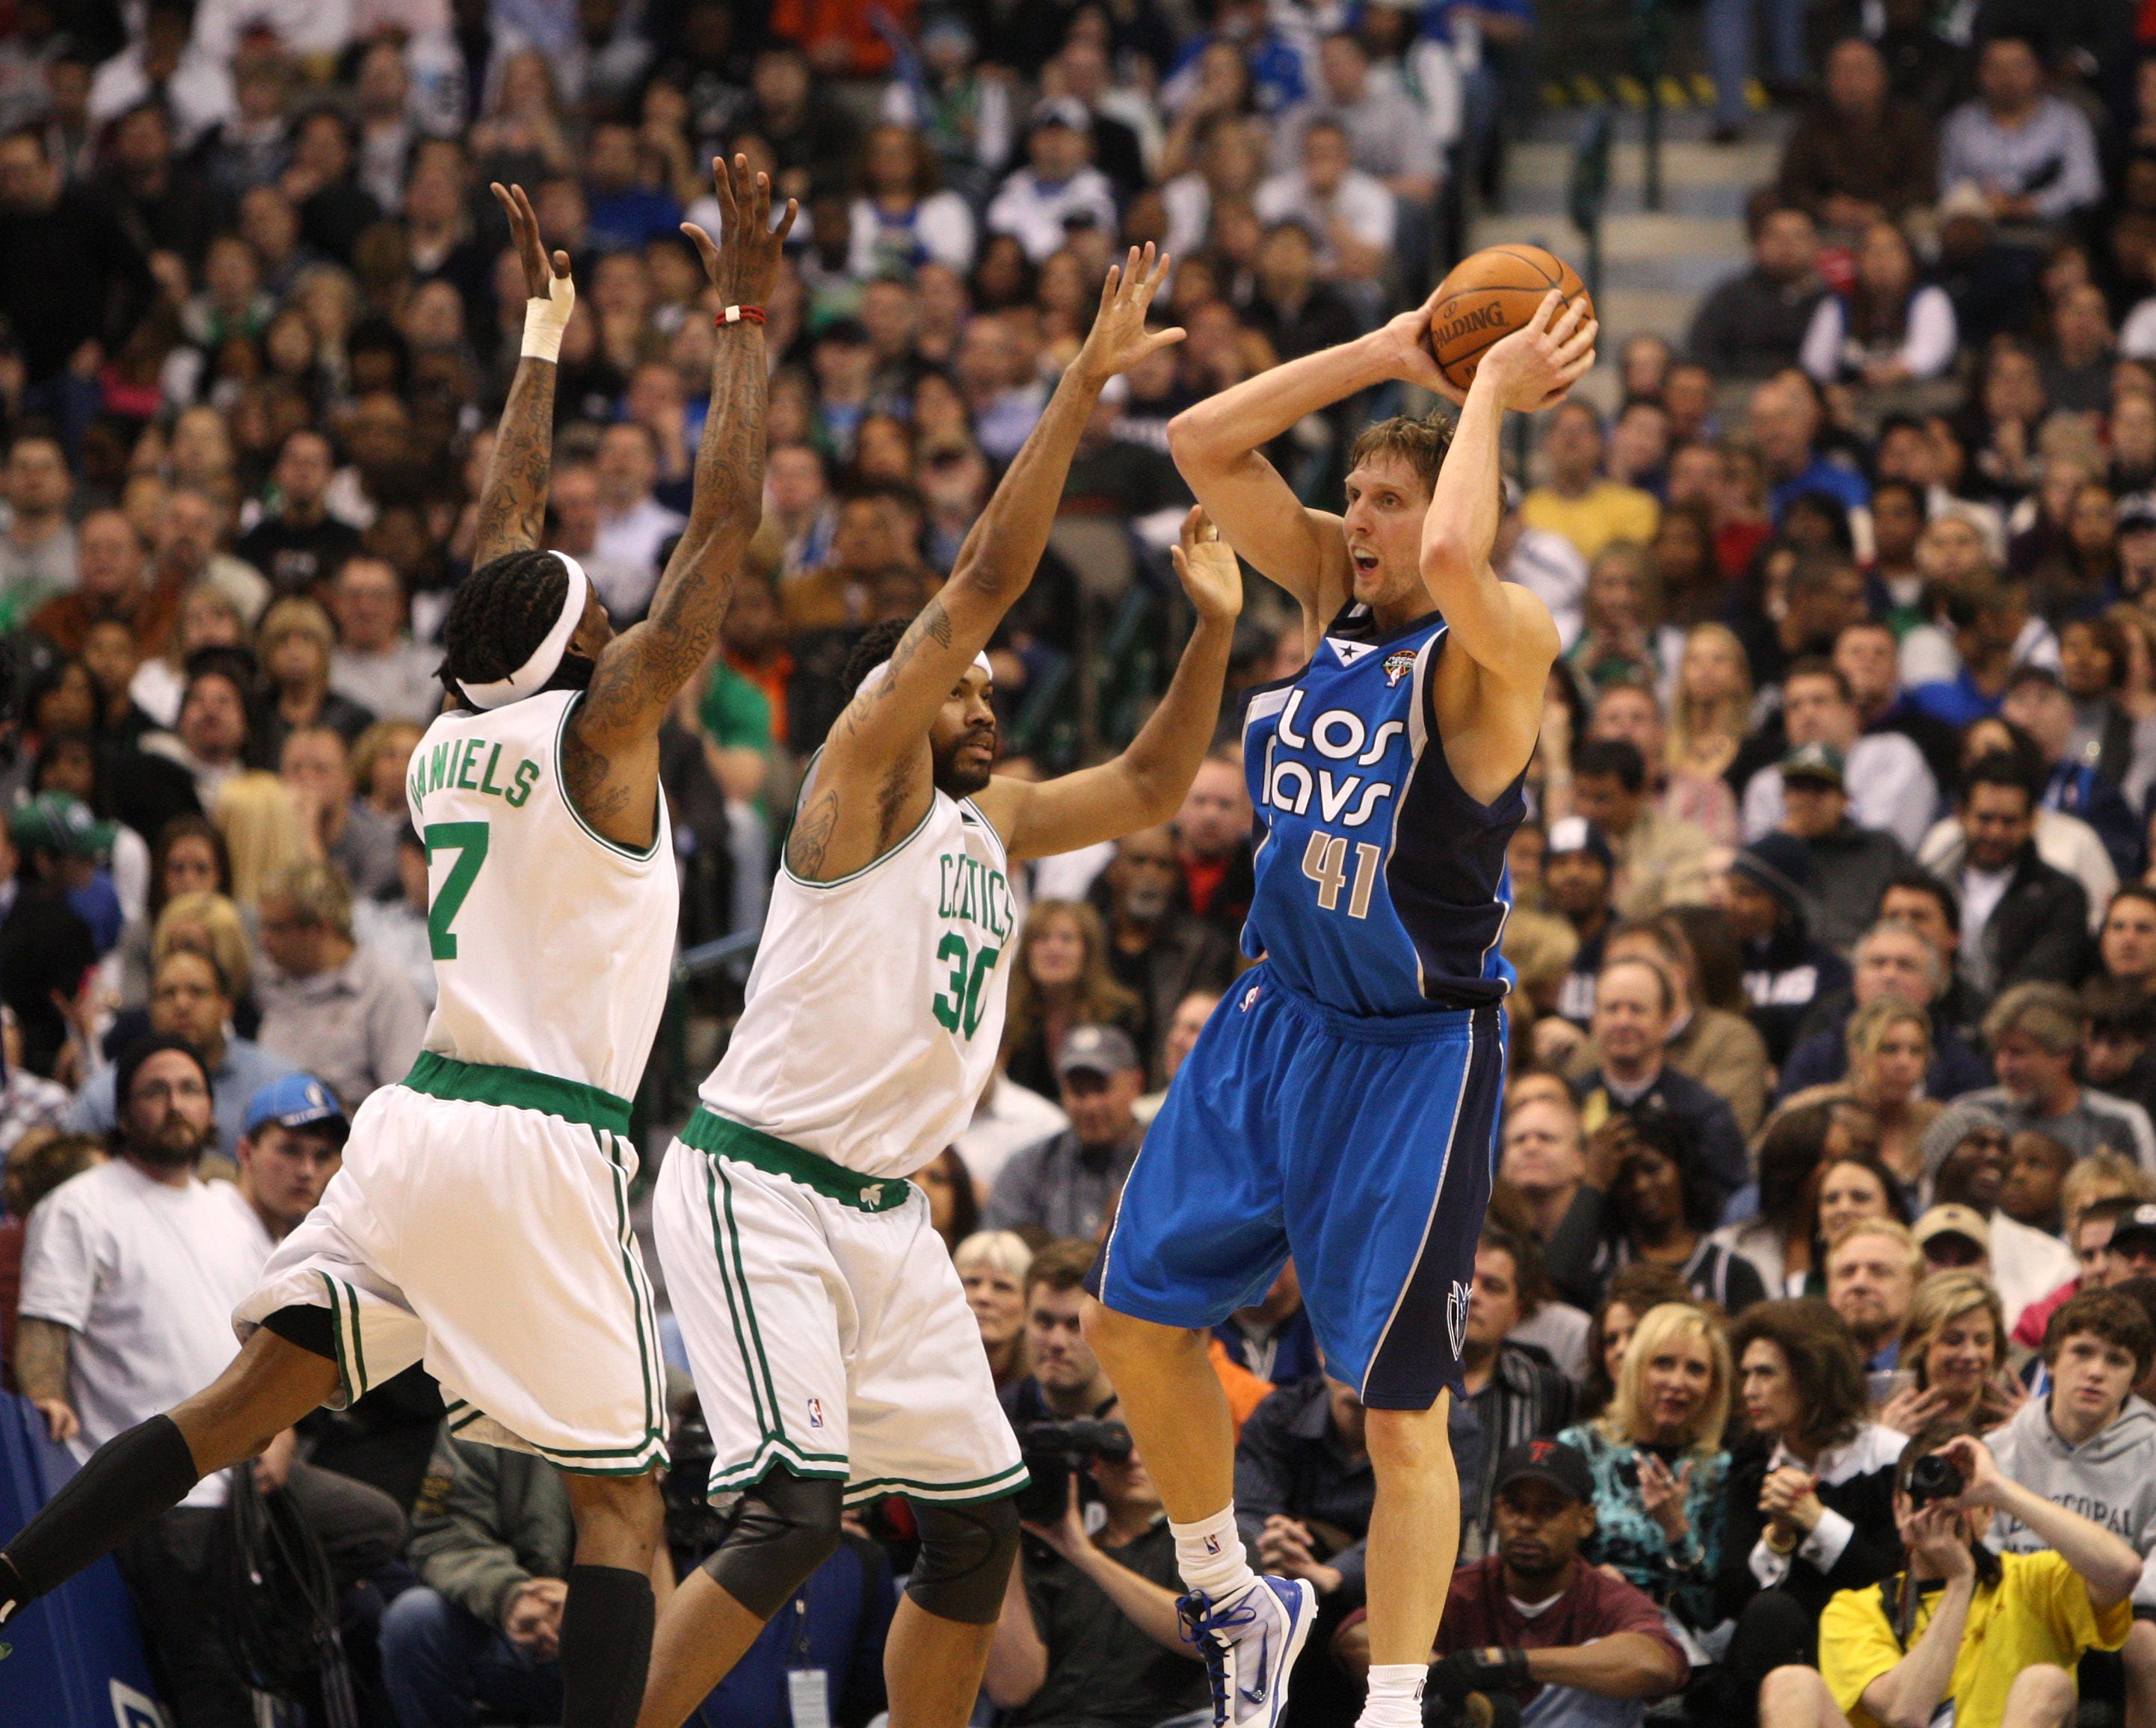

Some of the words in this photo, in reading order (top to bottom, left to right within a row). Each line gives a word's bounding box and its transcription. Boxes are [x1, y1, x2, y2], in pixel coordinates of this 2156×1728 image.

[1278, 689, 1404, 765] LOS
[423, 821, 490, 960] 7
[1302, 830, 1382, 919] 41
[932, 930, 1000, 1042] 30
